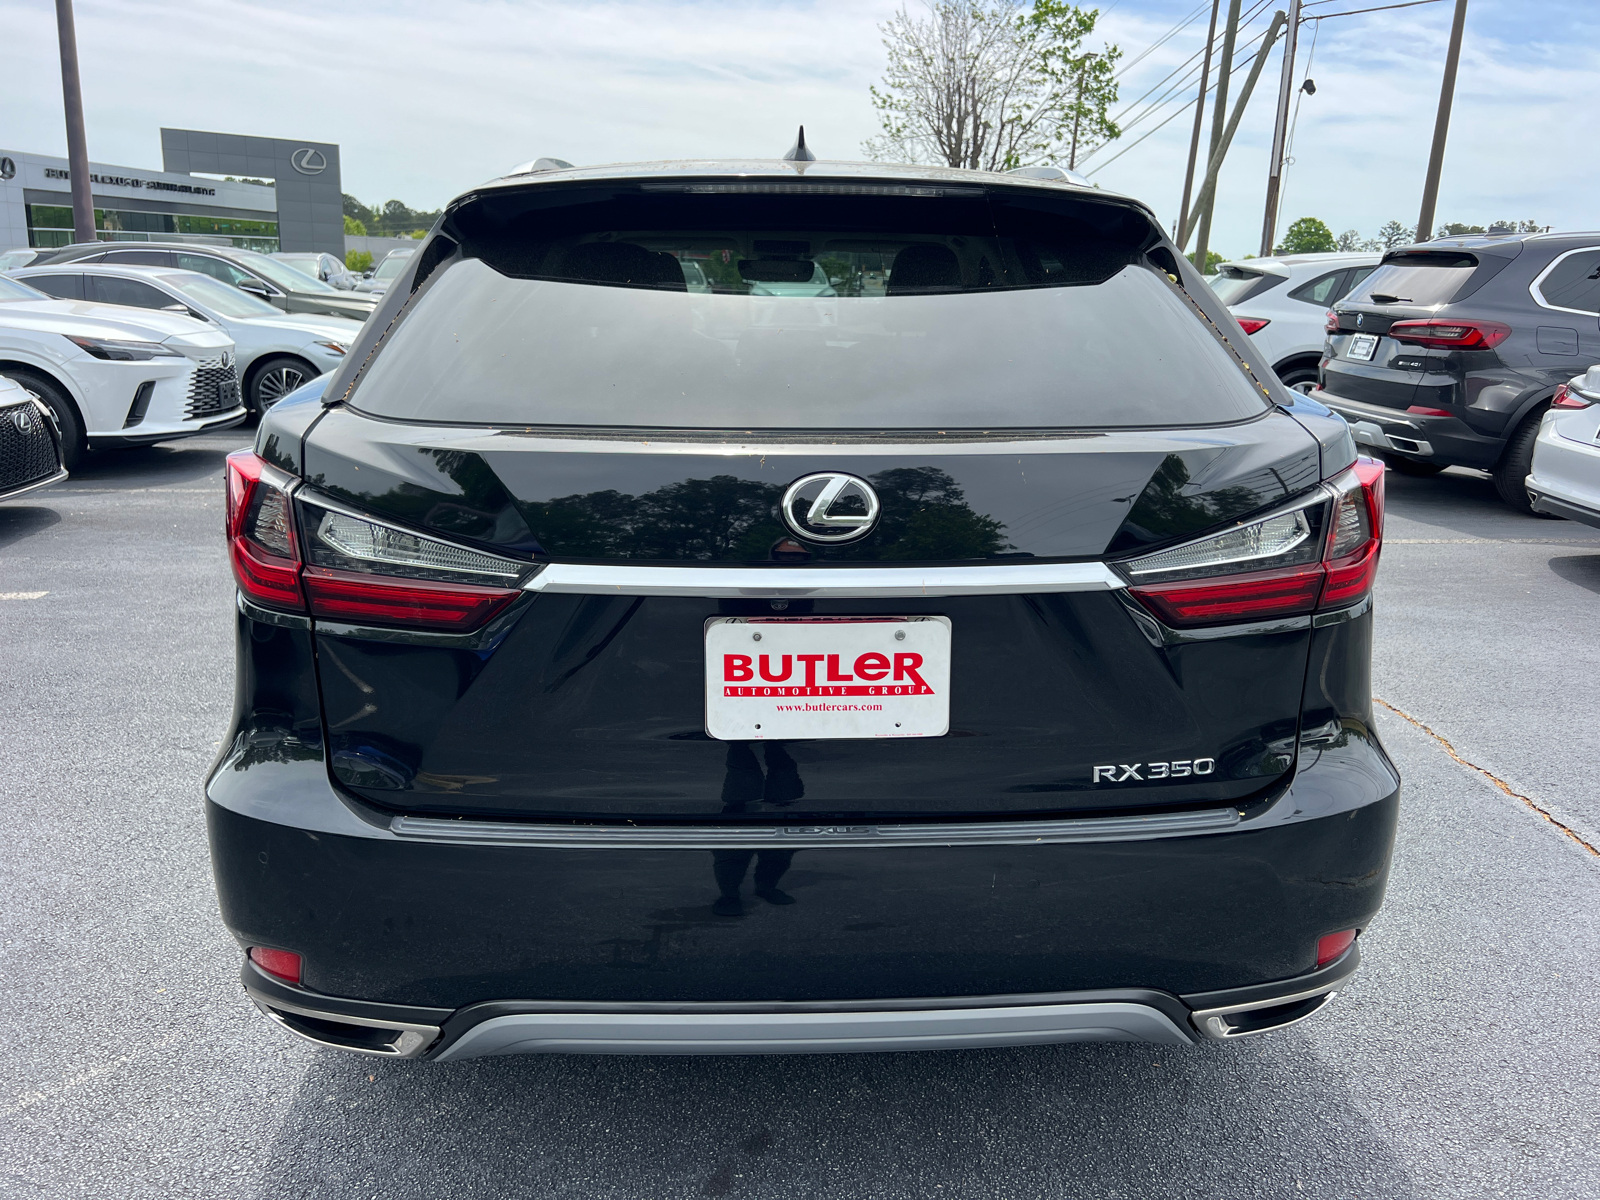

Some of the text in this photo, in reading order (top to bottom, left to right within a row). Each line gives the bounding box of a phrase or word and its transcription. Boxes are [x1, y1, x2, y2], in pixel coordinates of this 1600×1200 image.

[725, 685, 927, 696] AUTOMOTIVE GROUP
[776, 703, 883, 712] www.butlercars.com
[1093, 757, 1215, 783] RX 350
[783, 826, 870, 836] LEXUS
